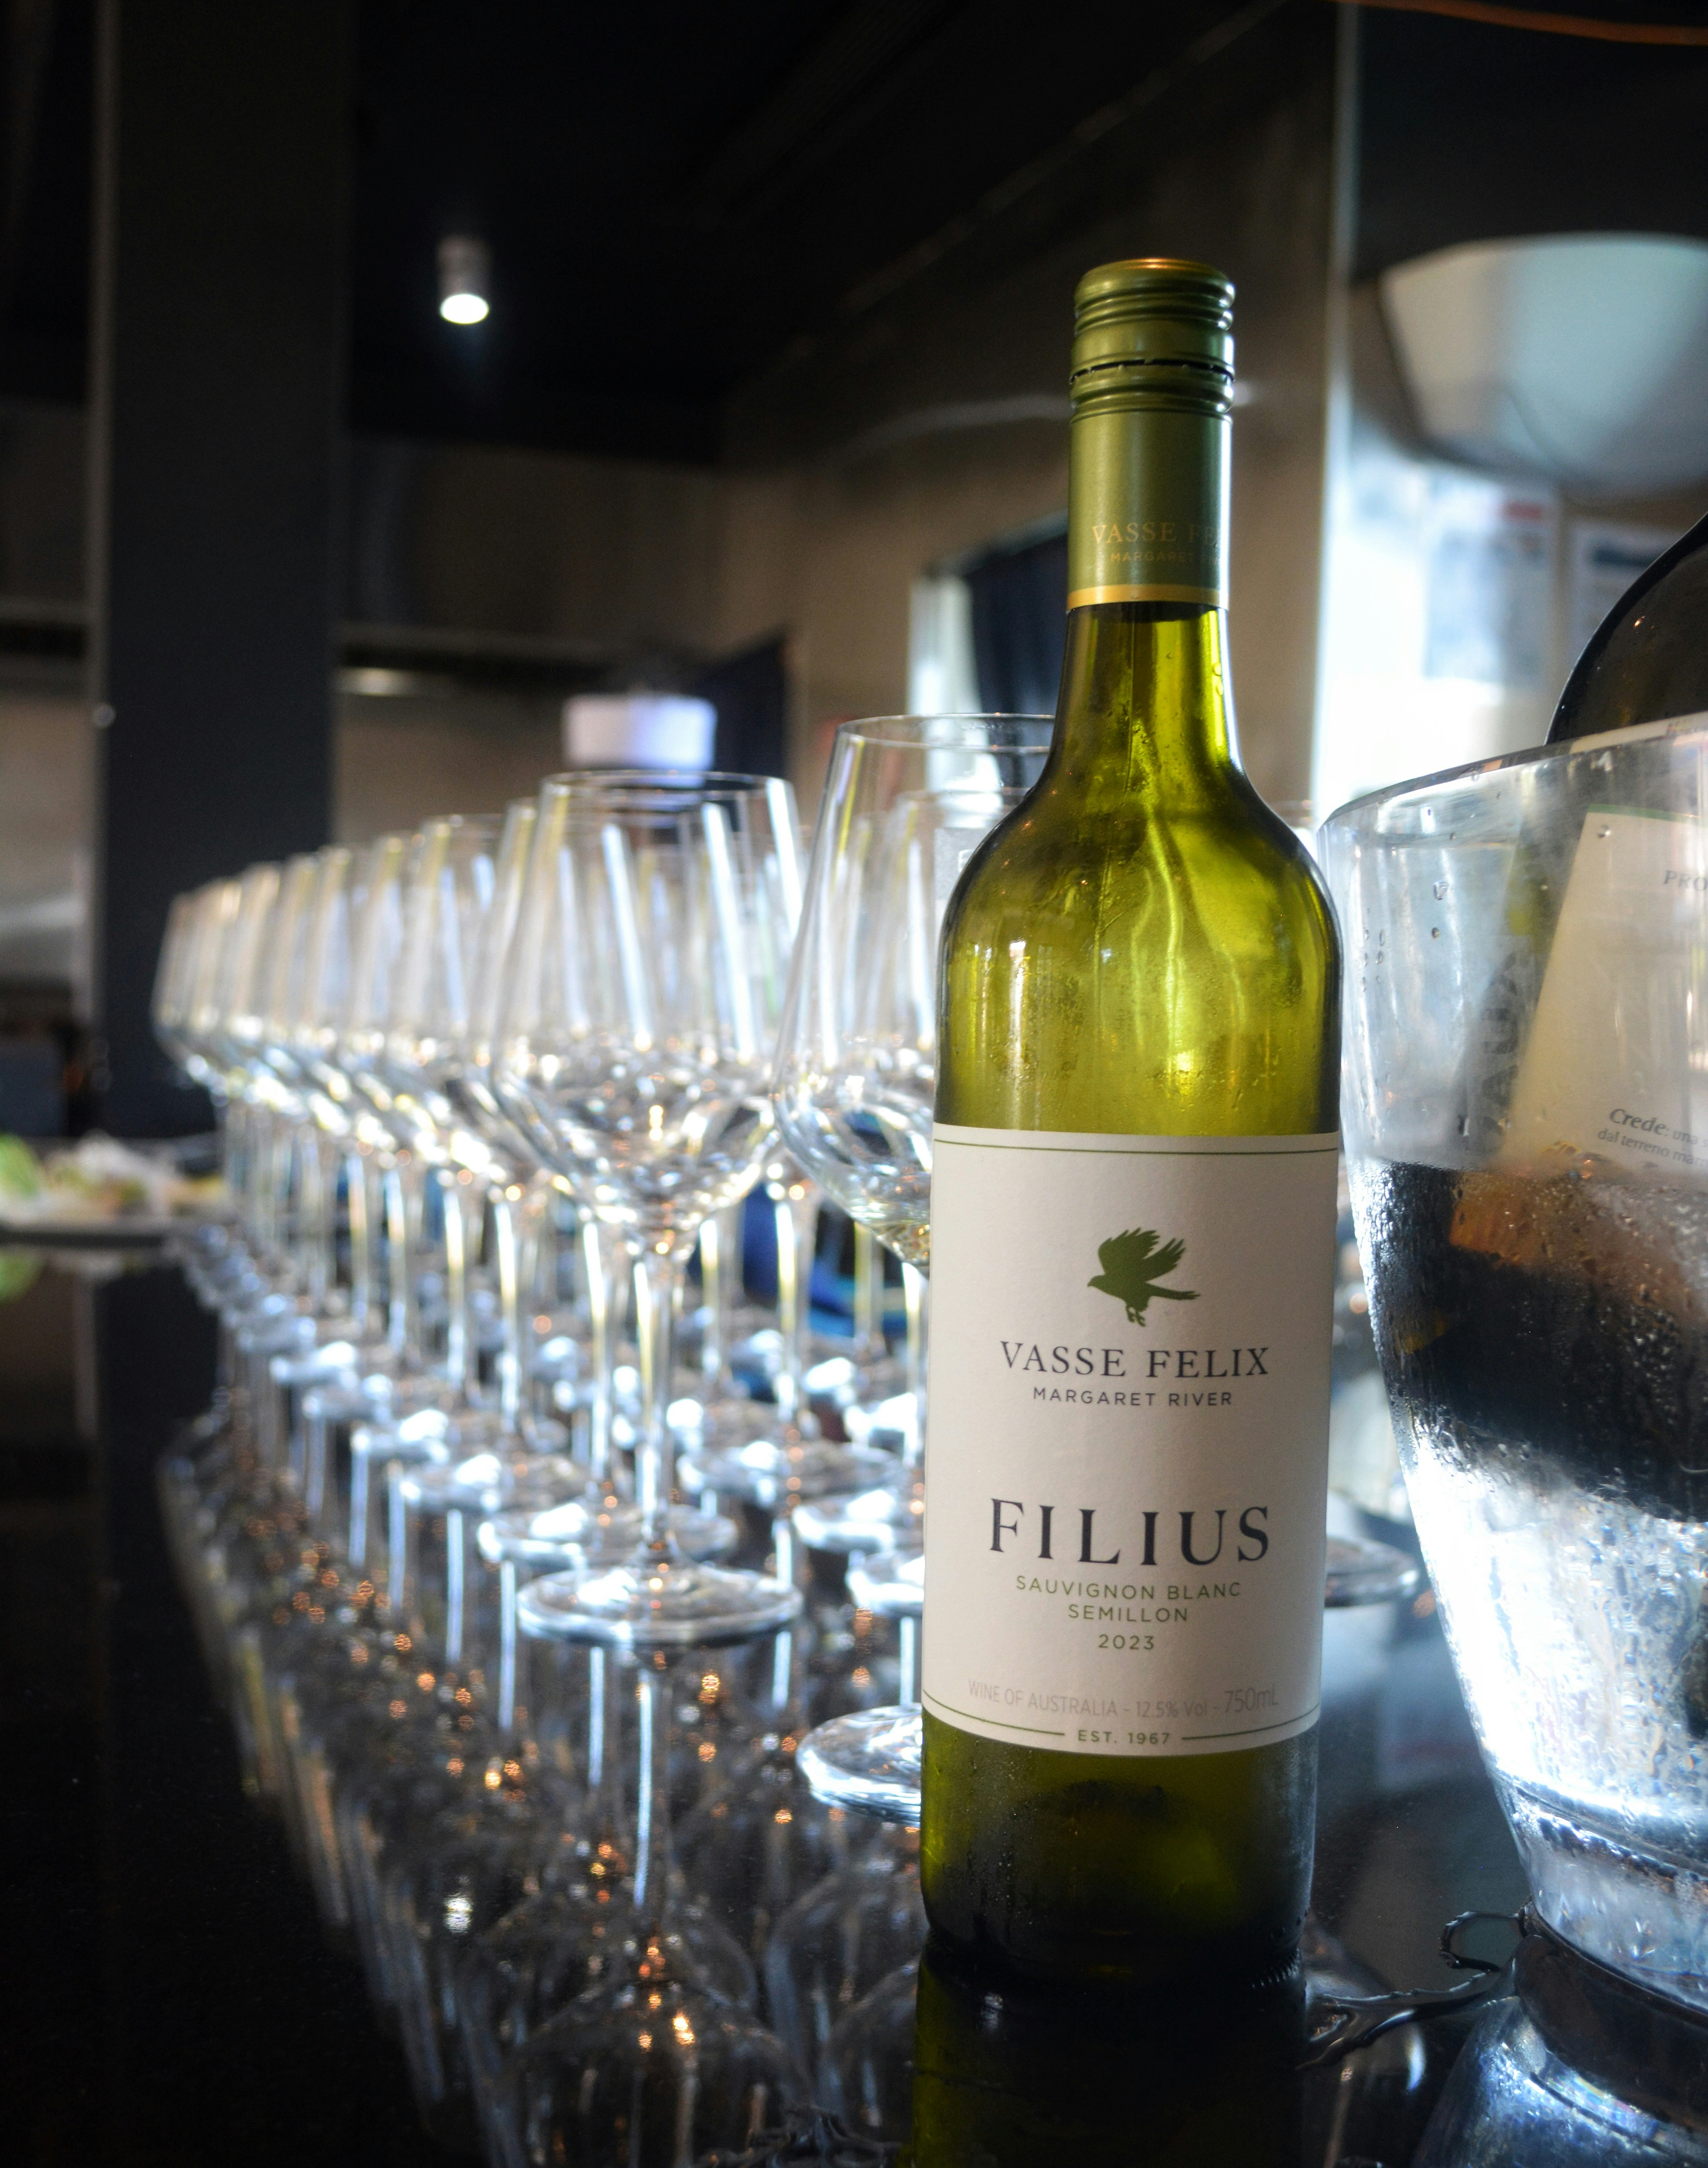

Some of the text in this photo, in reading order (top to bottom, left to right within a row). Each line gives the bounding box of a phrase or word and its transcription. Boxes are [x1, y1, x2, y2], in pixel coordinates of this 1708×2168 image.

[1092, 522, 1176, 544] VASSE
[1609, 1109, 1669, 1136] Crede:
[1673, 1130, 1698, 1145] una
[1597, 1128, 1619, 1143] dal
[1621, 1135, 1669, 1157] terreno
[1000, 1341, 1269, 1377] VASSE FELIX
[1033, 1387, 1232, 1406] MARGARET RIVER
[990, 1498, 1269, 1566] FILIUS
[1016, 1576, 1240, 1600] SAUVIGNON BLANC
[1068, 1604, 1188, 1622] SEMILLON
[1098, 1634, 1154, 1650] 2023
[968, 1679, 1000, 1702] WINE
[1005, 1688, 1024, 1705] OF
[1027, 1693, 1118, 1717] AUSTRALIA
[1136, 1701, 1179, 1718] 12.5%
[1183, 1699, 1208, 1717] Vol
[1078, 1730, 1170, 1744] EST. 1967
